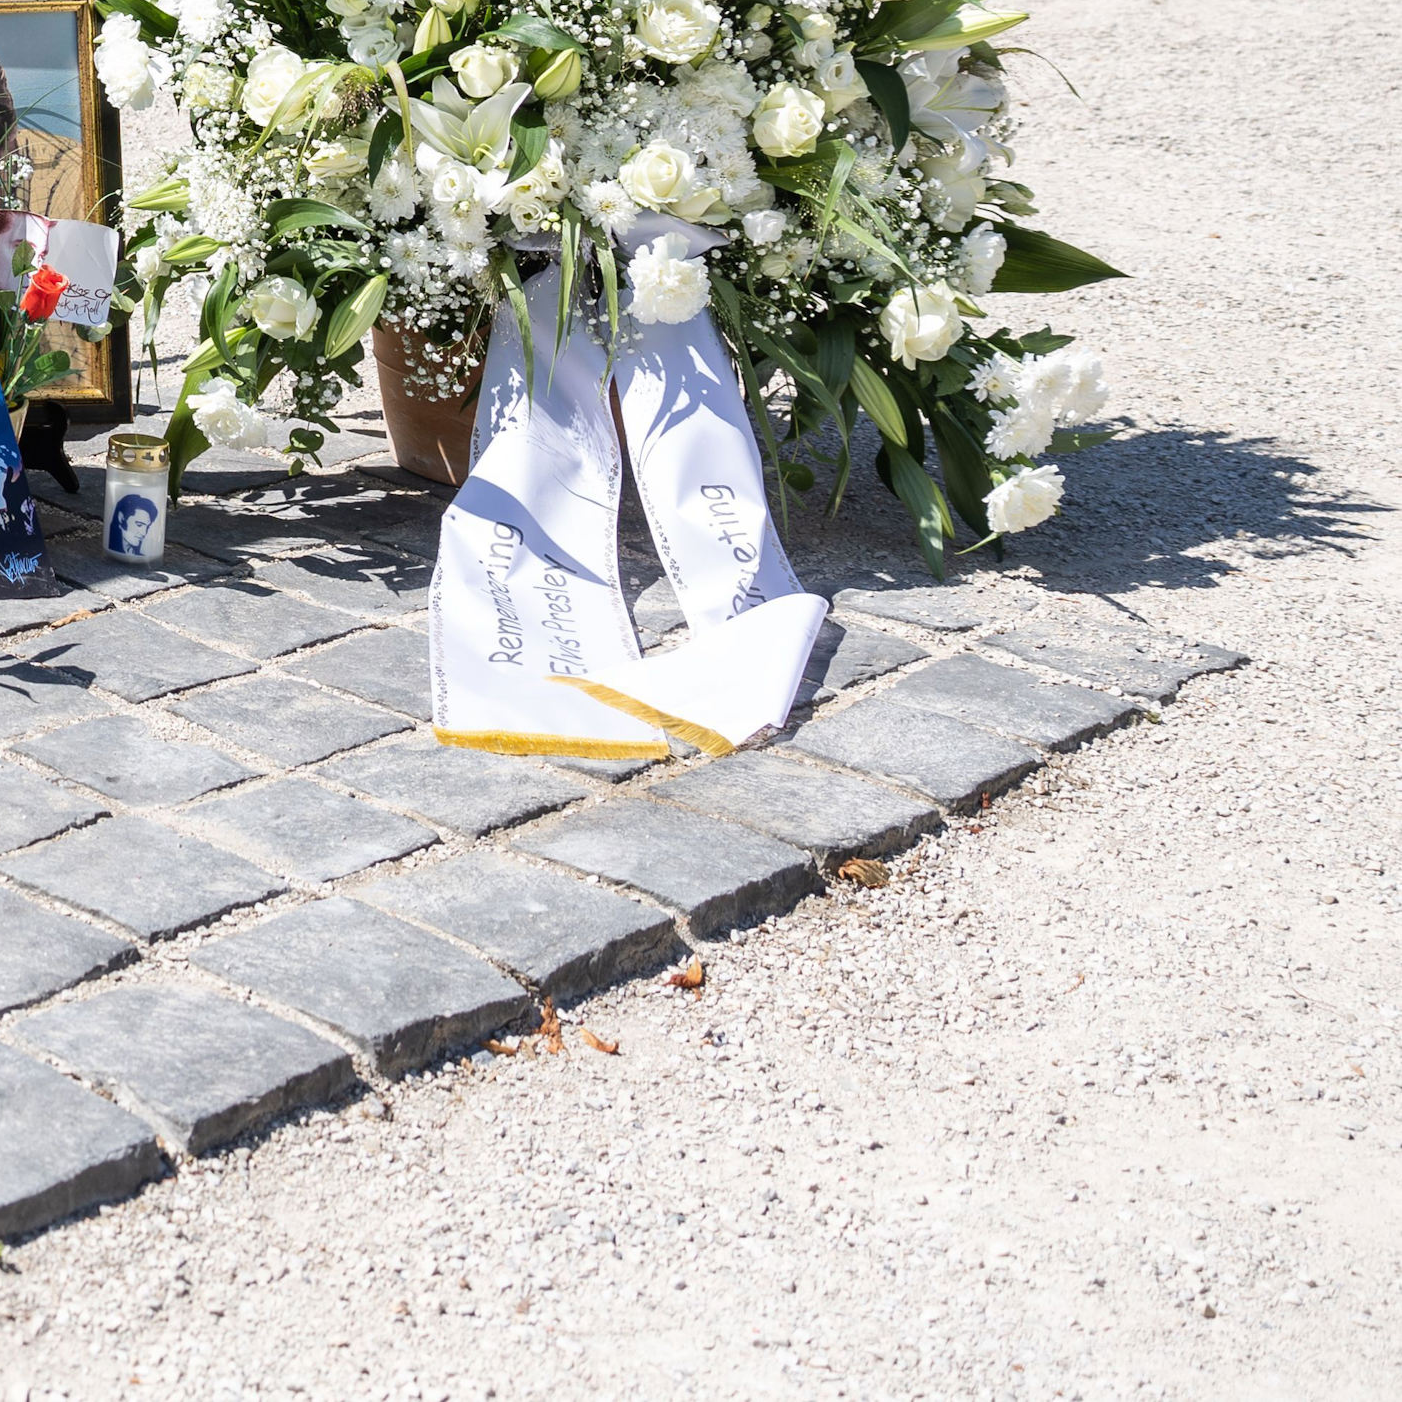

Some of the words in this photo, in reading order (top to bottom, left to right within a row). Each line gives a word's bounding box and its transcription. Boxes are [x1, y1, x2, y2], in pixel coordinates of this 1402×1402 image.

[479, 522, 524, 666] Remembering
[533, 553, 577, 632] Presley
[549, 636, 589, 676] Elvis
